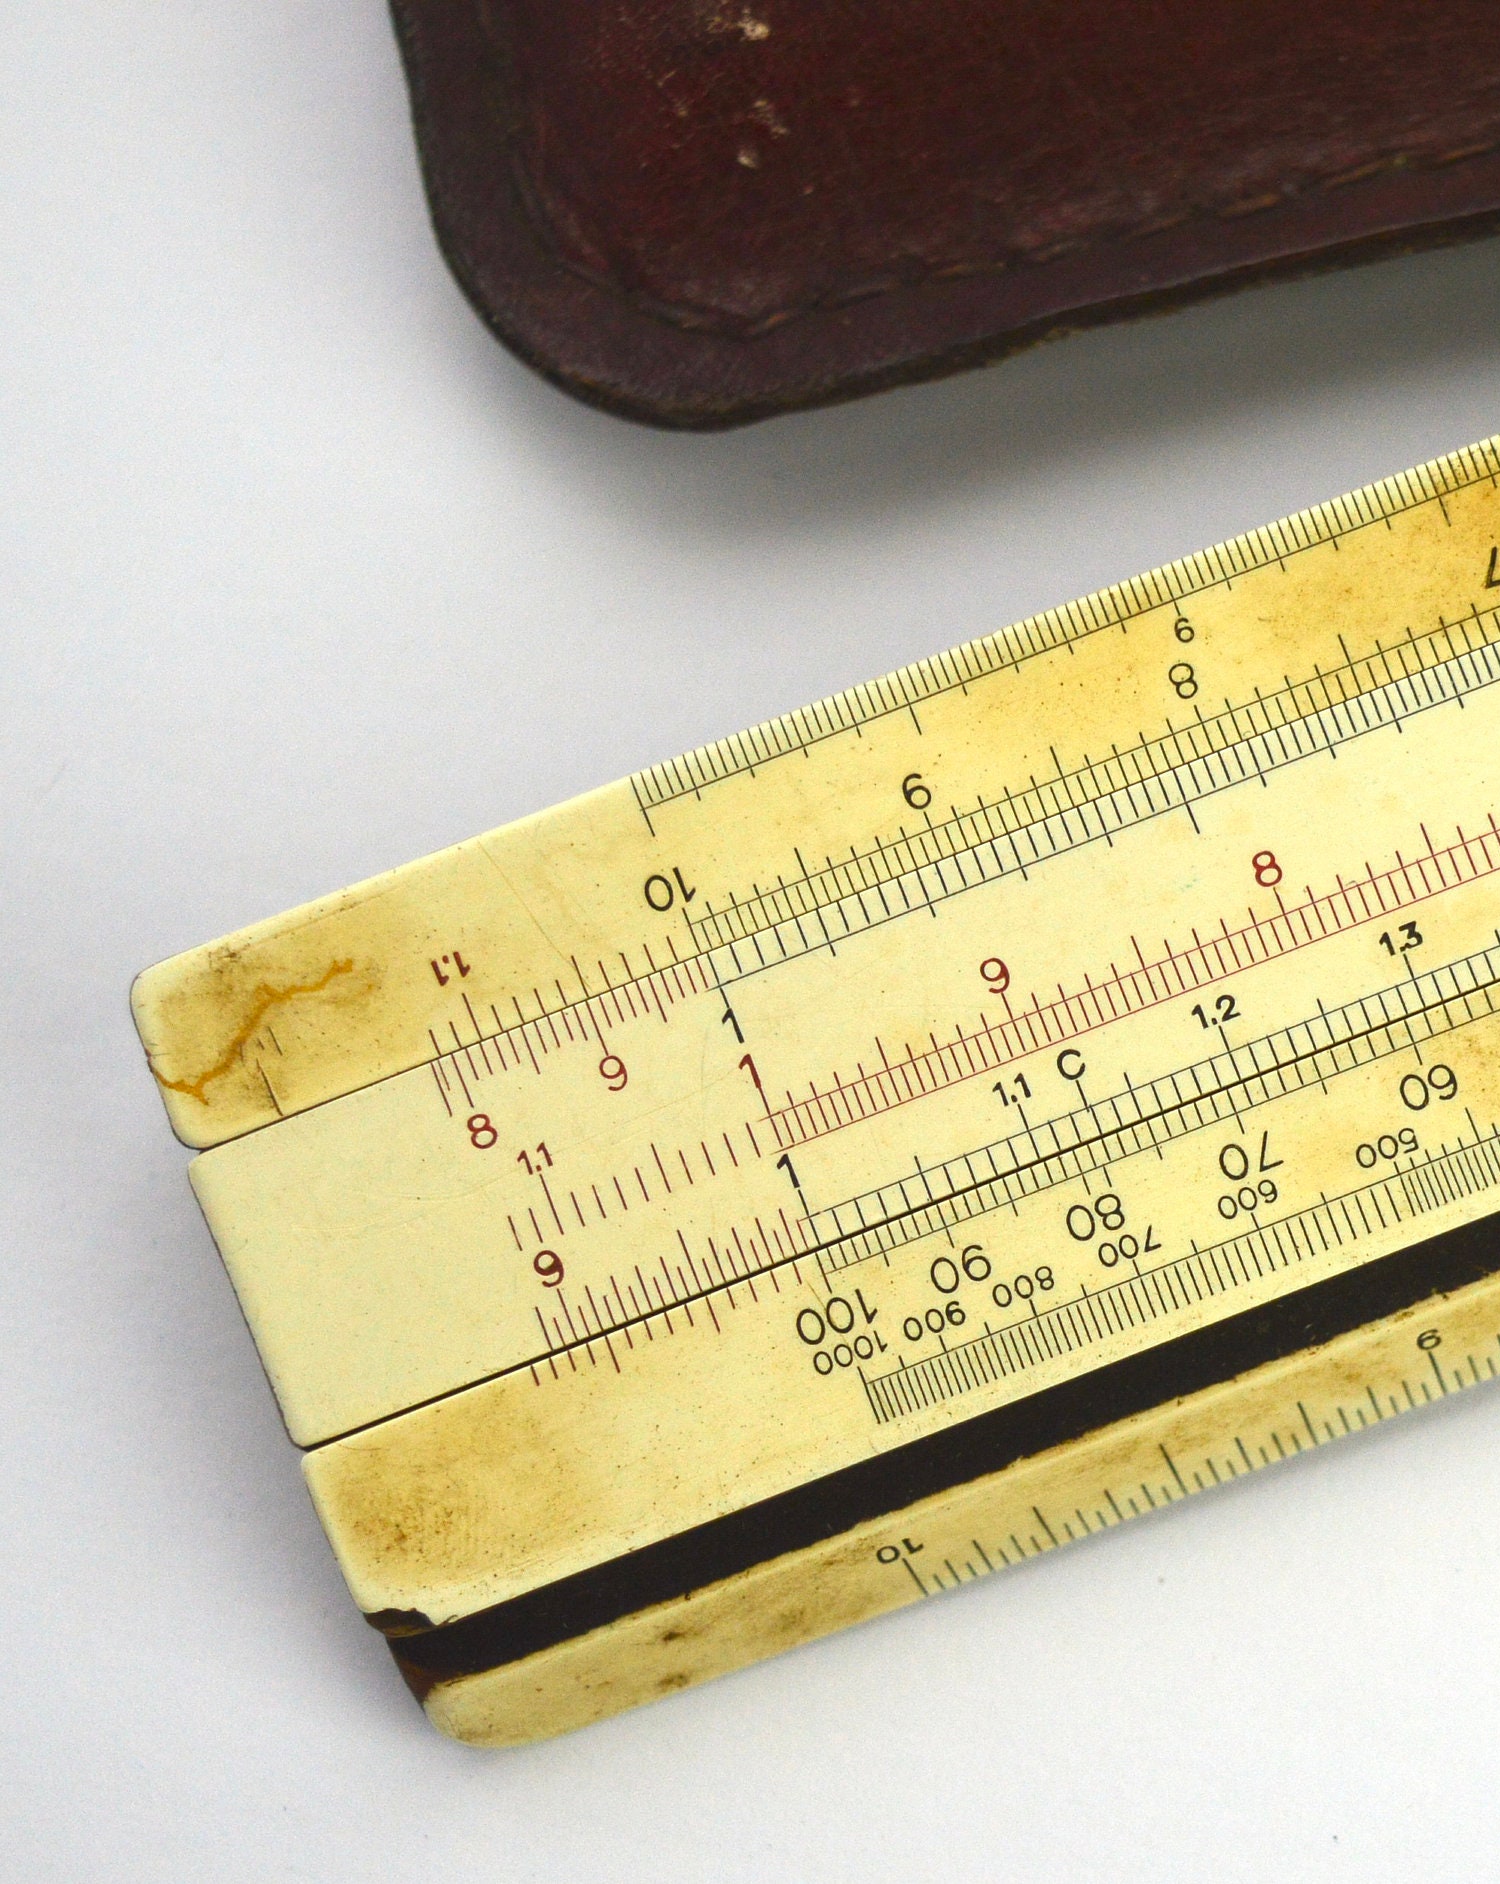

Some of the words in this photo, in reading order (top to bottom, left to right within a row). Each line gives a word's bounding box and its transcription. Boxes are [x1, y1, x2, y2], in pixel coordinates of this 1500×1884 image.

[1170, 664, 1198, 700] 8
[1252, 851, 1283, 888] 8
[645, 867, 695, 911] 10
[1379, 922, 1424, 958] 1.3
[431, 951, 471, 986] 1.1
[980, 958, 1010, 994] 9
[720, 1009, 744, 1044] 1
[1192, 996, 1241, 1030] 1.2
[600, 1056, 627, 1091] 9
[738, 1054, 761, 1089] 1
[1057, 1049, 1085, 1081] C
[992, 1074, 1031, 1107] 1.1
[1400, 1064, 1458, 1111] 60
[467, 1115, 498, 1149] 8
[1355, 1129, 1419, 1169] 500
[517, 1142, 553, 1175] 1.1
[776, 1154, 800, 1189] 1
[1220, 1131, 1284, 1181] 70
[1066, 1194, 1126, 1241] 80
[1217, 1180, 1278, 1220] 600
[1100, 1225, 1162, 1268] 700
[534, 1251, 563, 1286] 9
[930, 1245, 992, 1294] 90
[992, 1266, 1054, 1308] 800
[796, 1289, 878, 1345] 100
[903, 1301, 966, 1341] 900
[812, 1331, 888, 1375] 1000
[876, 1537, 923, 1564] 10
